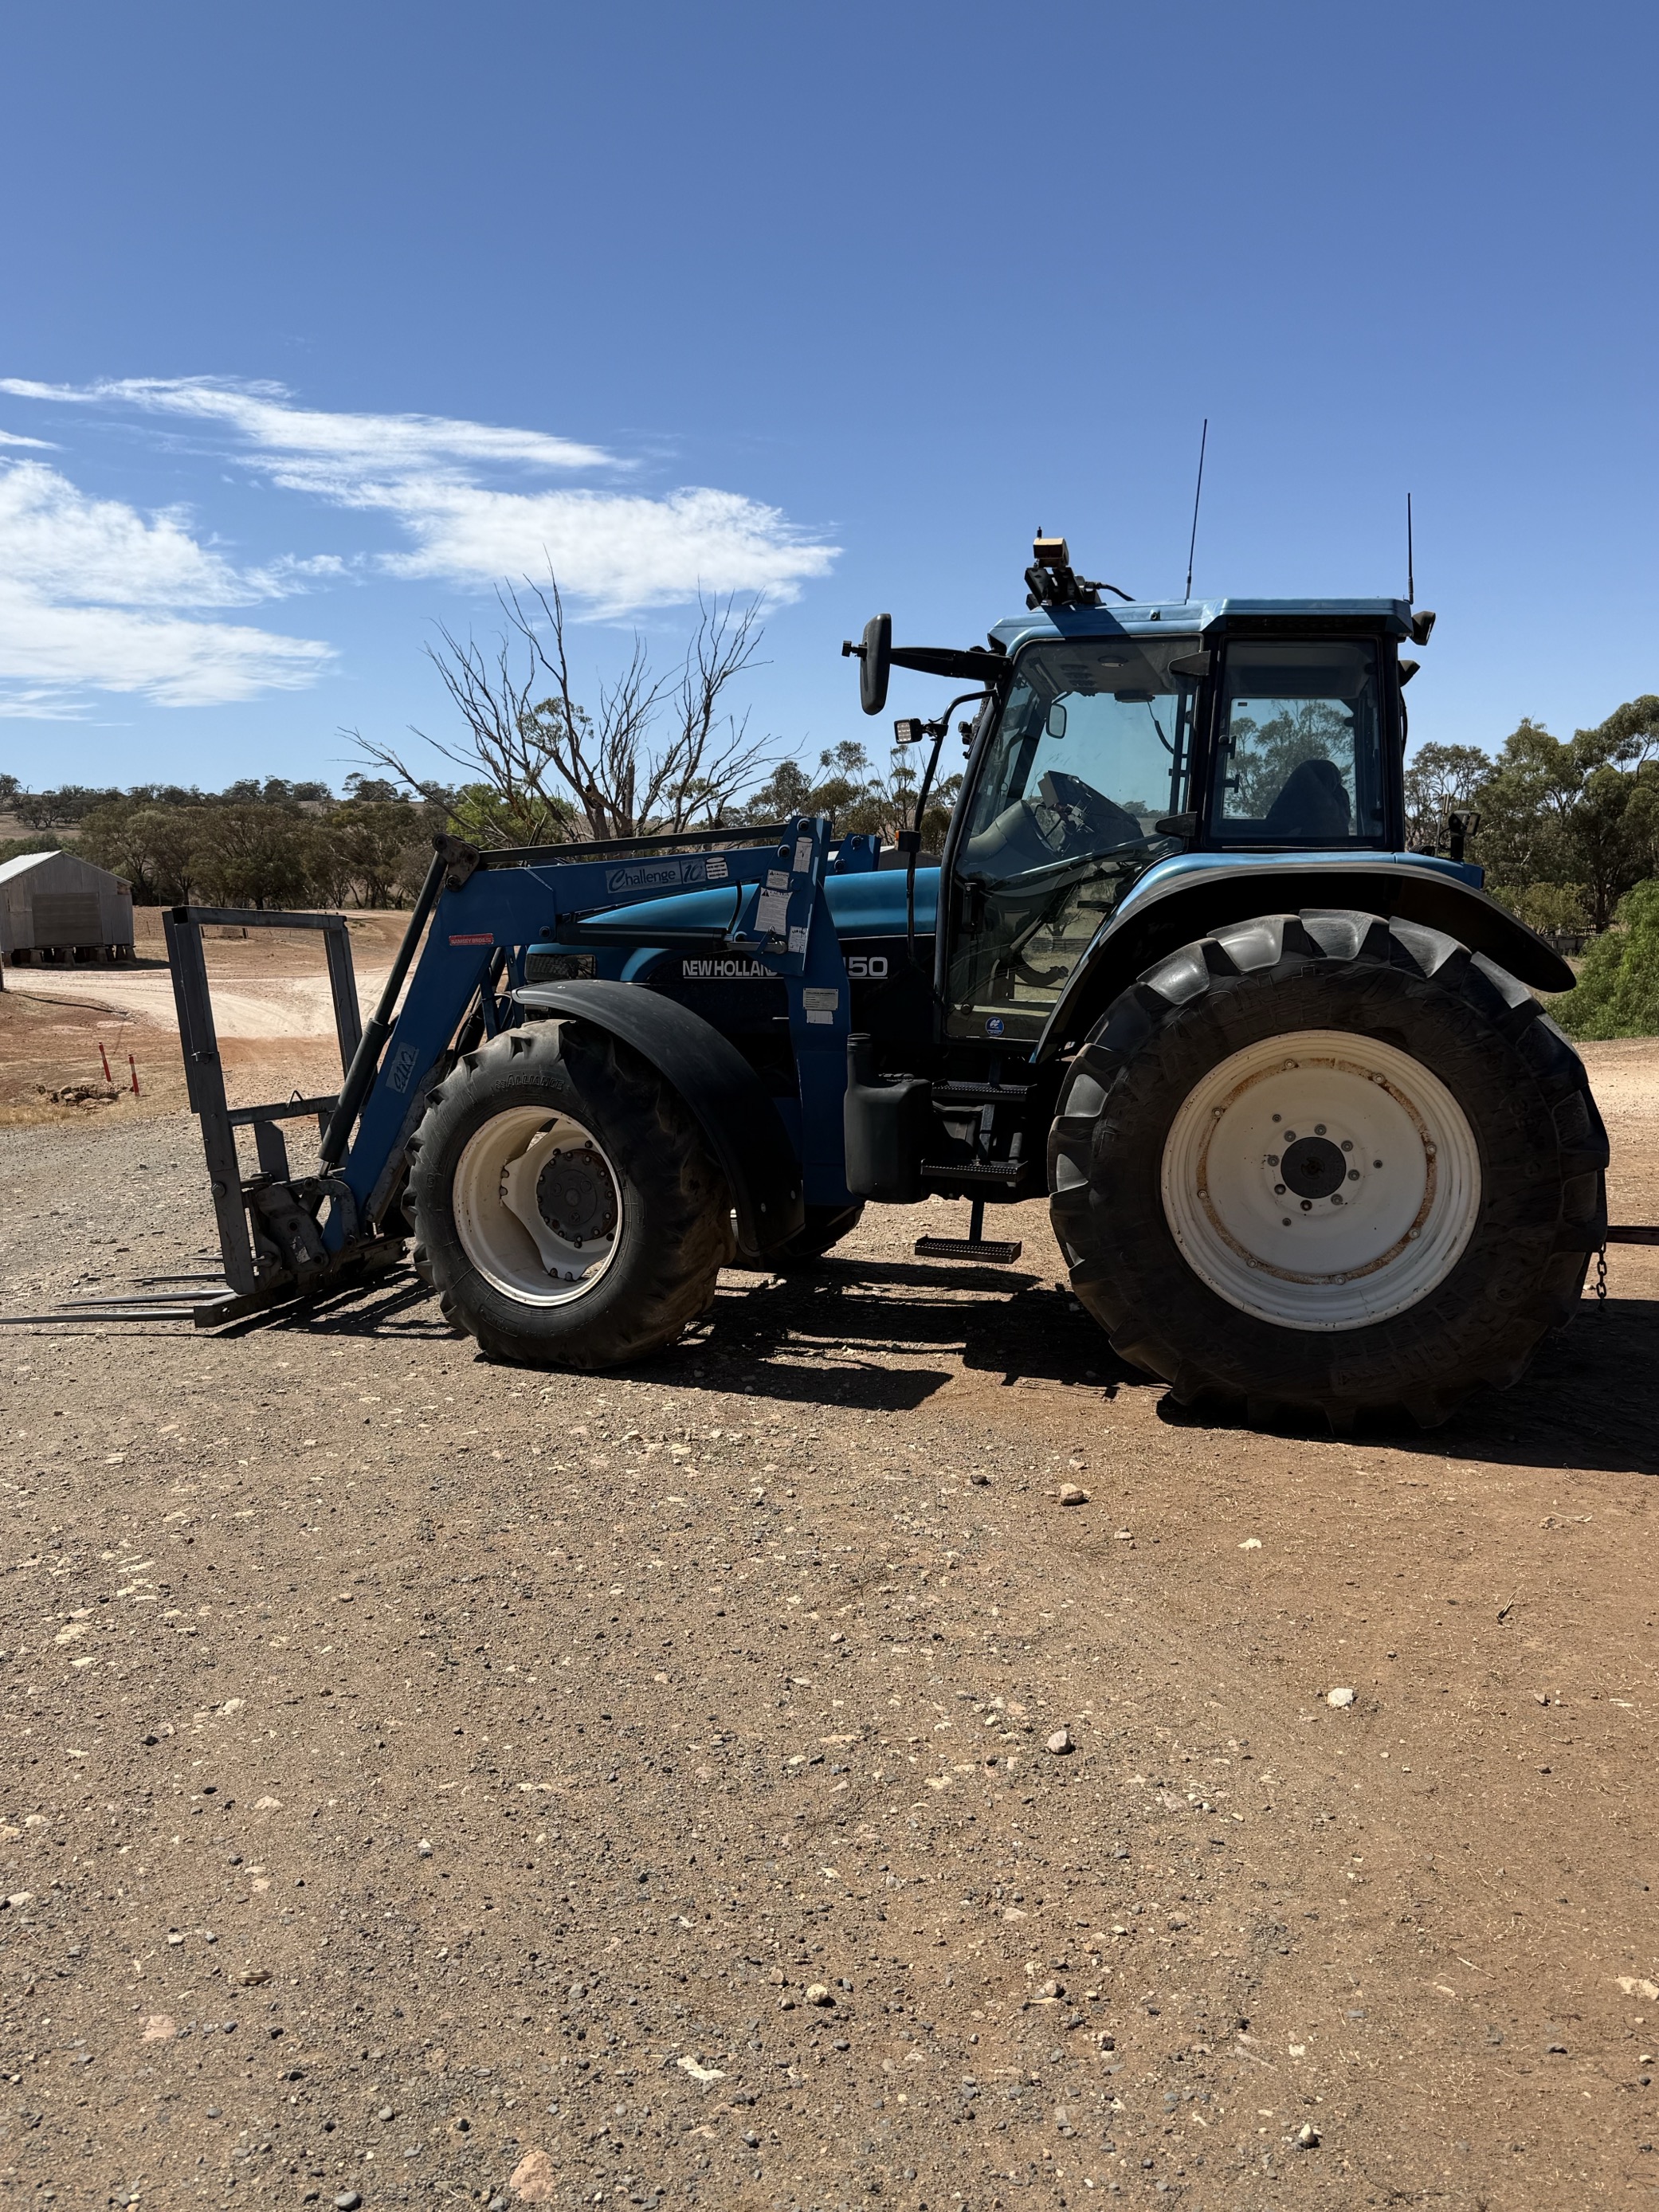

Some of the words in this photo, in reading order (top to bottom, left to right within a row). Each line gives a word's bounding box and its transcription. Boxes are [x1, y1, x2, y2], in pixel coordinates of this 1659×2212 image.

[608, 869, 676, 892] Challenge
[683, 864, 703, 883] 10
[683, 960, 712, 976] NEW
[507, 1073, 565, 1090] ALLIANCE
